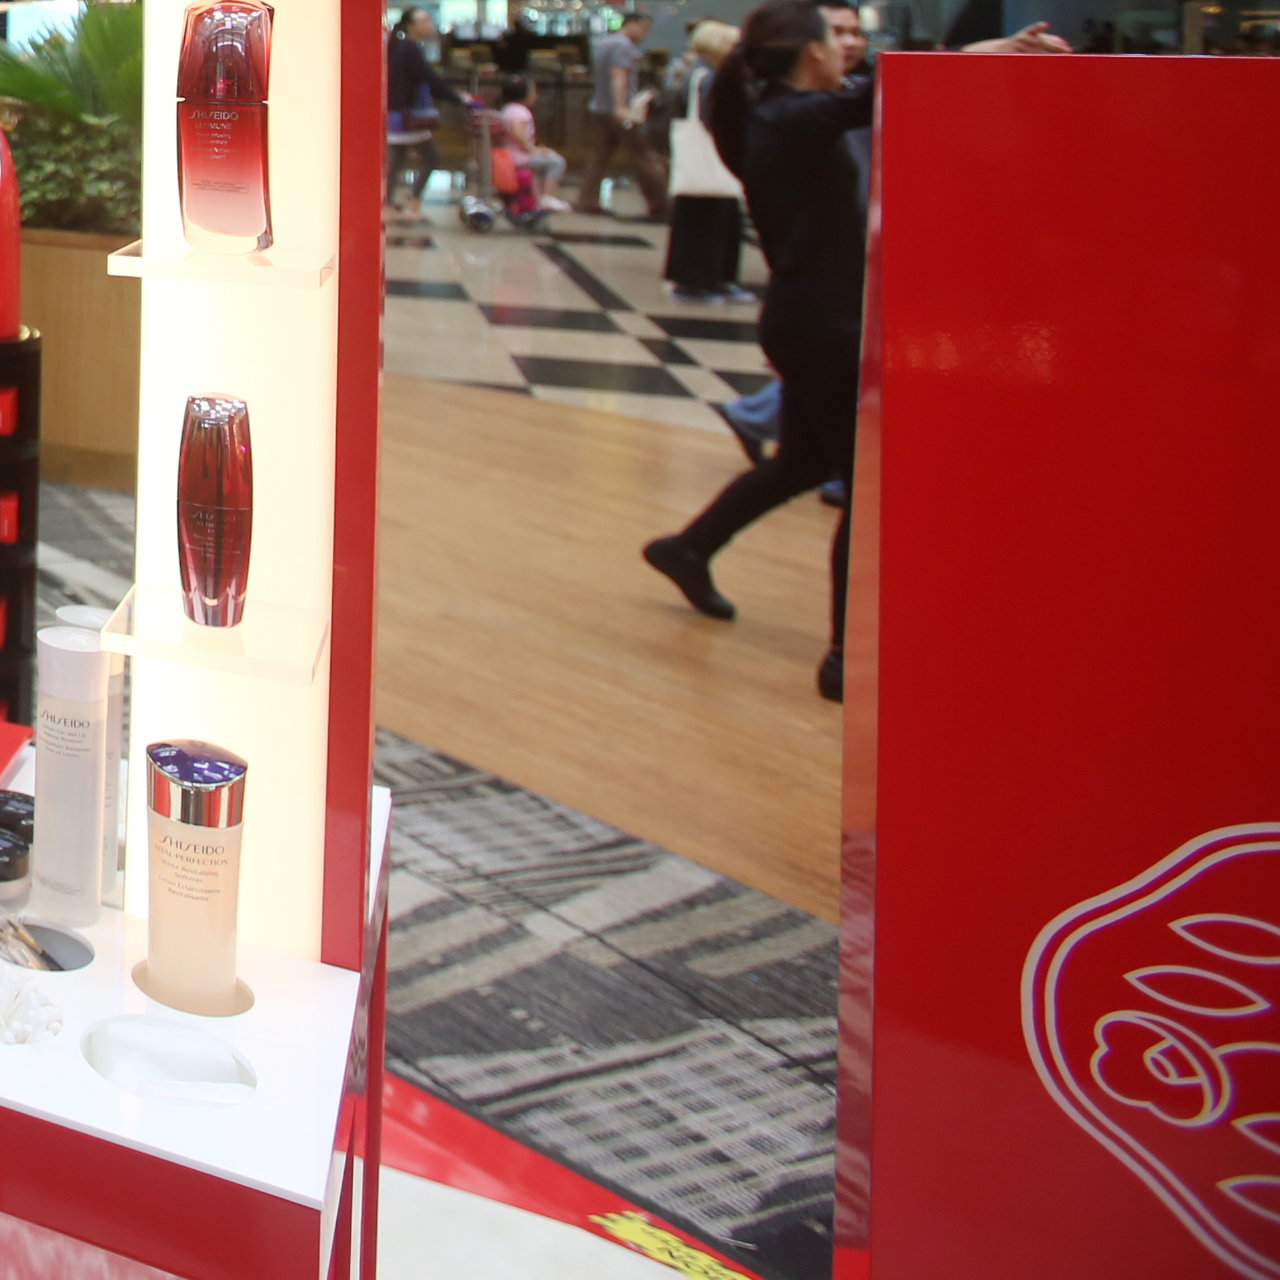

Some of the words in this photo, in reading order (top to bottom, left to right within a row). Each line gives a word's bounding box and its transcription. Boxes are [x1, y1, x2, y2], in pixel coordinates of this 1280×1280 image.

[189, 109, 239, 121] SHISEIDO
[41, 710, 91, 729] SHISEIDO
[159, 835, 225, 855] SHISEIDO
